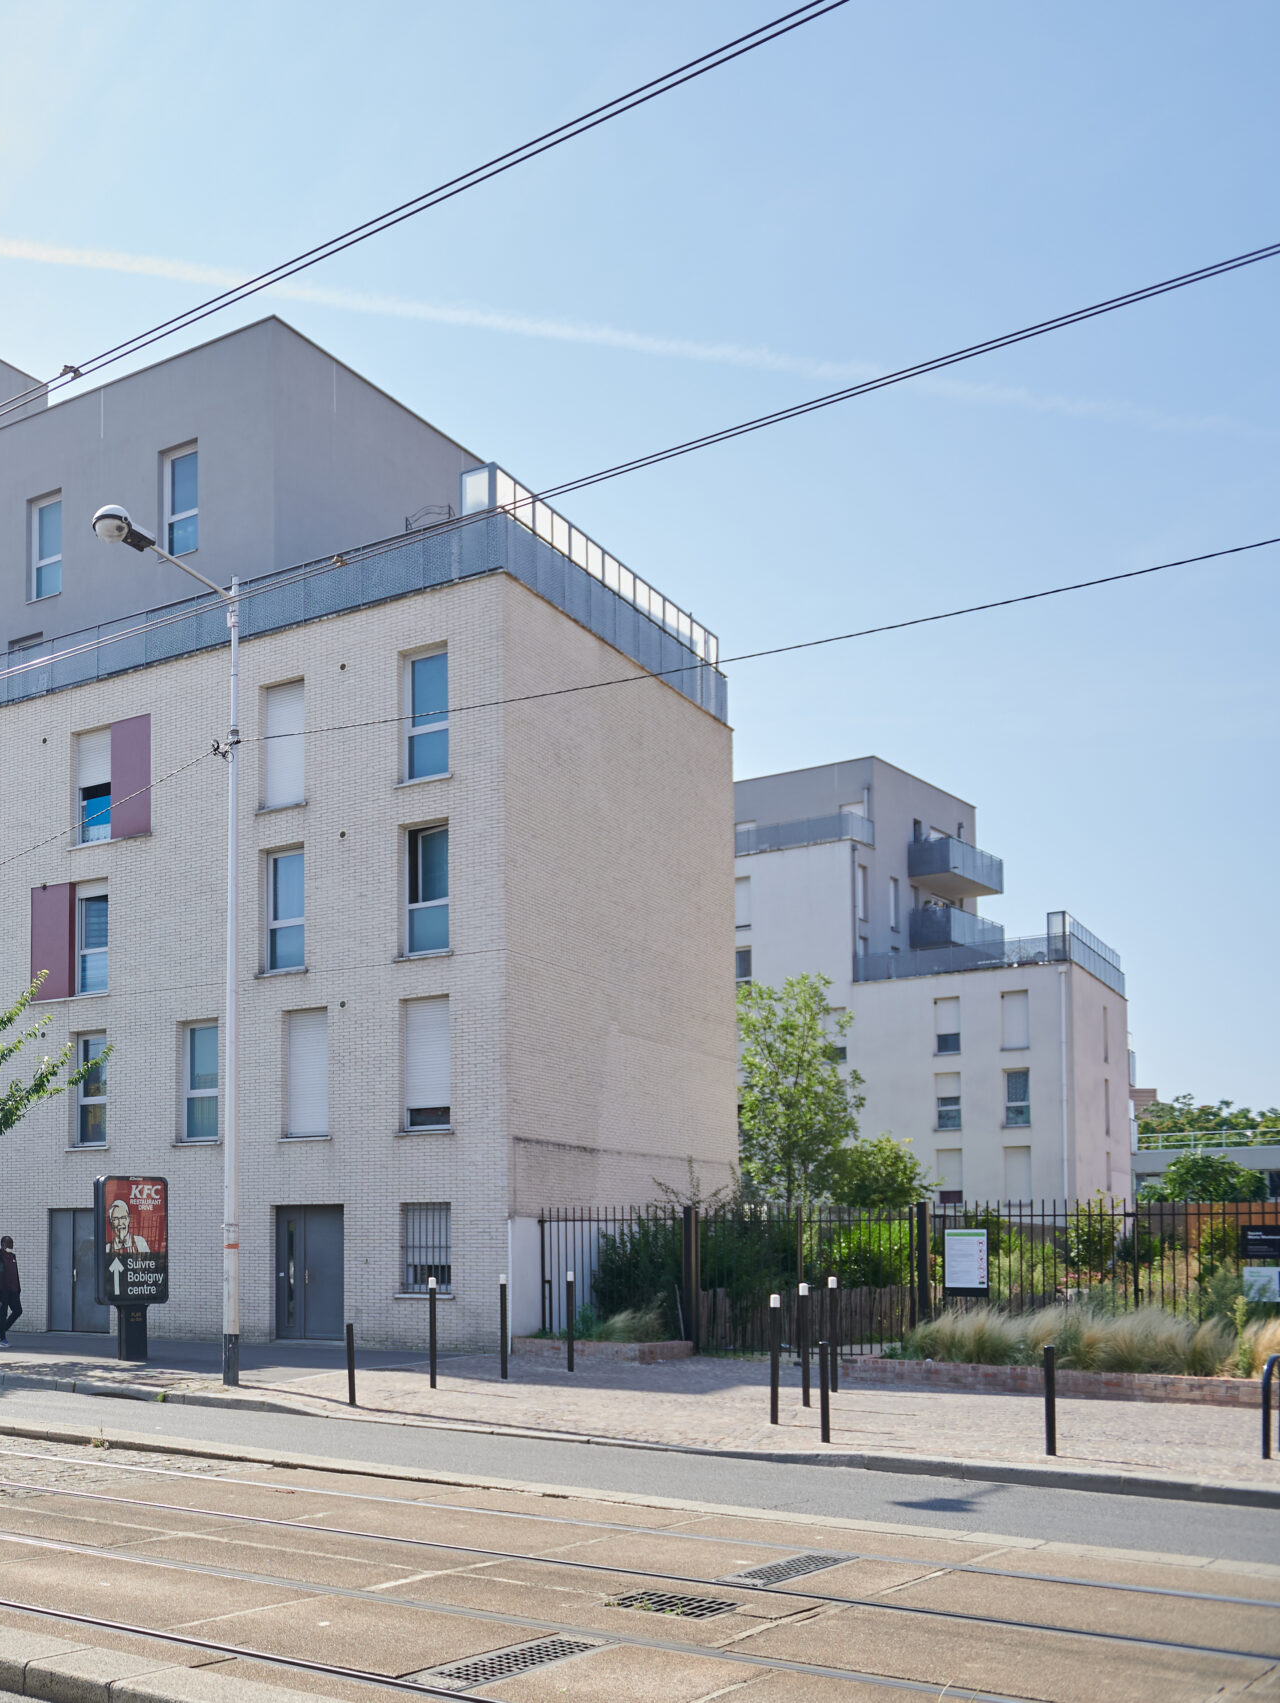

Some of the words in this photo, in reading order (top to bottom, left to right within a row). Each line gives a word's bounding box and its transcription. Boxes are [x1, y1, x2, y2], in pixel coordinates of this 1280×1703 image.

[129, 1184, 162, 1199] KFC
[127, 1258, 156, 1269] Suivre
[127, 1271, 164, 1284] Bobigny
[127, 1285, 157, 1295] centre
